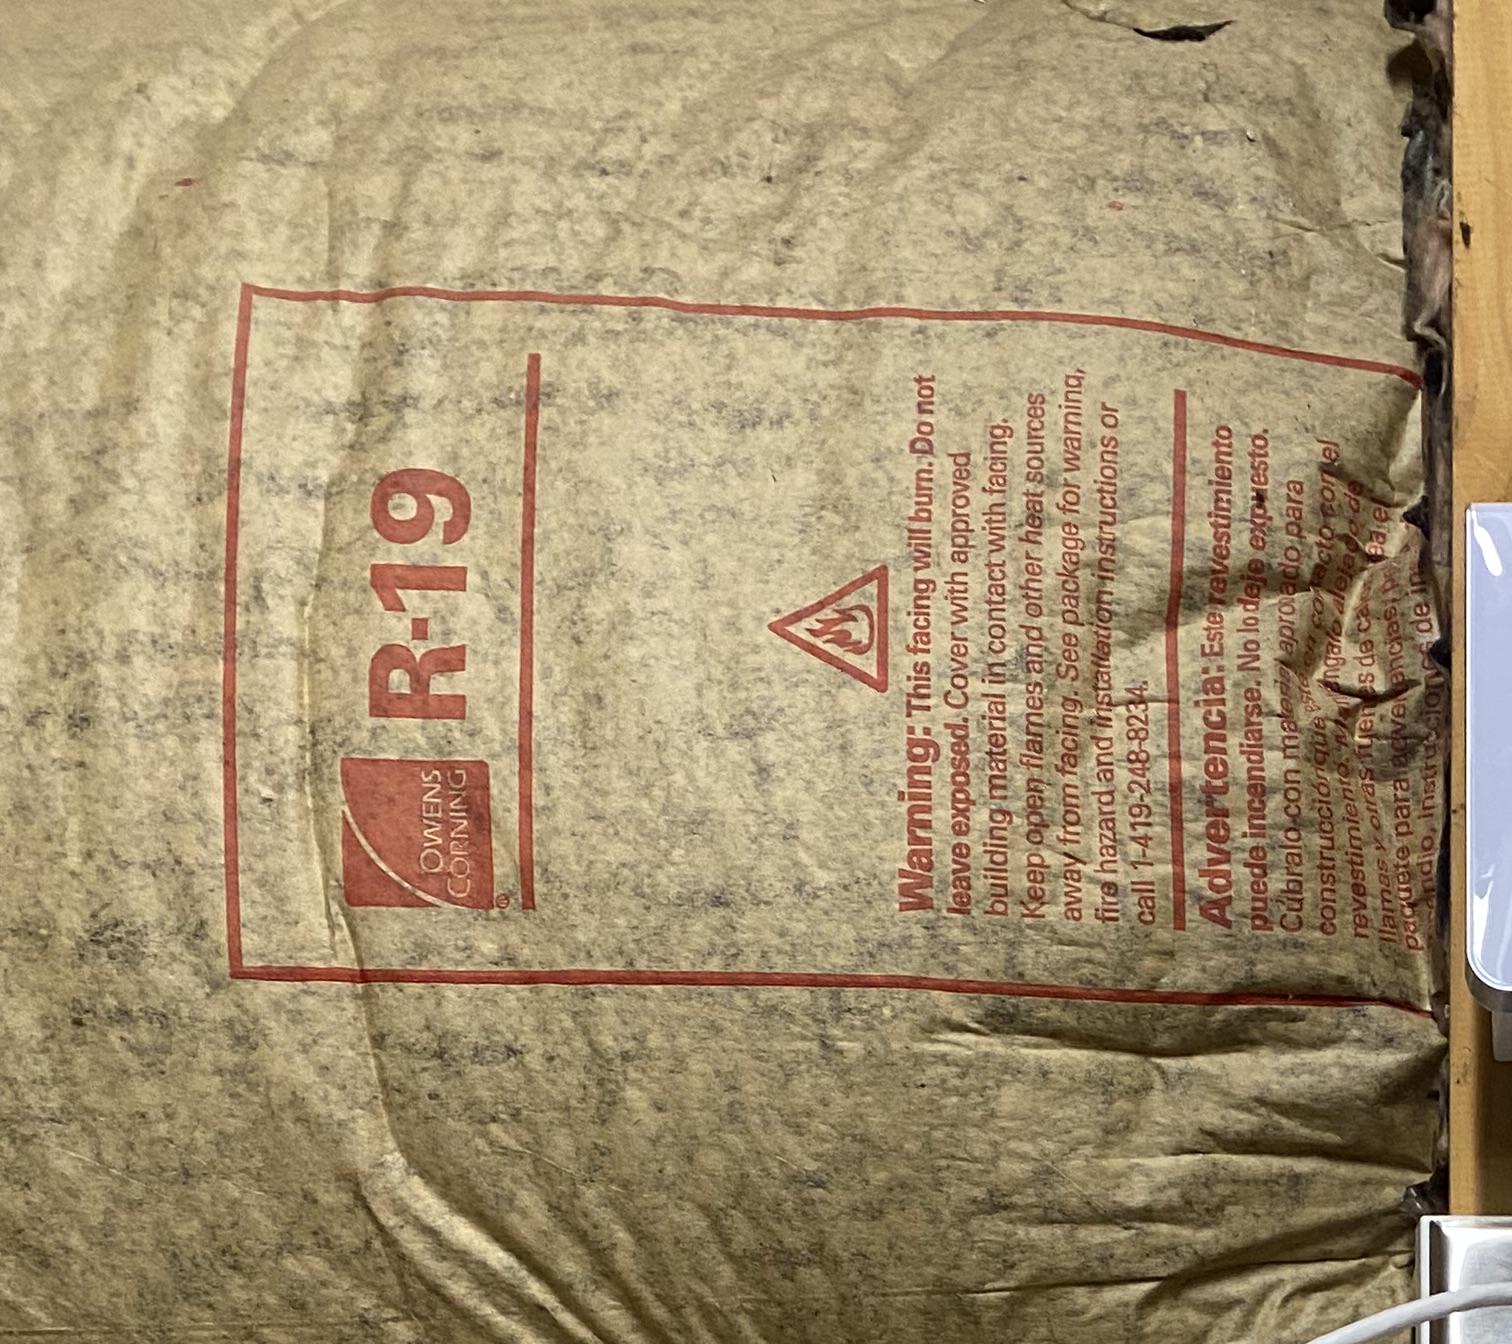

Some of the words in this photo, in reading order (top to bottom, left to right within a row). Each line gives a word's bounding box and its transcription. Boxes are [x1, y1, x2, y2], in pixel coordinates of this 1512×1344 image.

[914, 375, 934, 415] not
[1063, 369, 1084, 472] warning,
[1101, 402, 1118, 430] or
[908, 420, 934, 458] Do
[982, 419, 1014, 495] facing.
[1026, 394, 1045, 482] sources
[907, 463, 933, 525] burn.
[948, 451, 972, 564] approved
[983, 502, 1007, 553] with
[1018, 491, 1044, 545] heat
[1057, 480, 1081, 514] for
[1097, 434, 1119, 580] instructions
[907, 528, 932, 571] will
[1019, 550, 1043, 618] other
[1056, 522, 1084, 626] package
[369, 466, 471, 721] R-19
[905, 577, 938, 655] facing
[947, 572, 968, 626] with
[985, 561, 1007, 654] contact
[943, 633, 969, 710] Cover
[982, 663, 1006, 684] in
[1020, 625, 1045, 673] and
[1056, 632, 1080, 681] See
[1090, 589, 1116, 729] installation
[905, 661, 931, 718] This
[1018, 682, 1044, 770] flames
[982, 693, 1007, 800] material
[1056, 692, 1084, 777] facing.
[1090, 735, 1114, 783] and
[944, 717, 976, 838] exposed.
[1025, 776, 1049, 847] open
[1124, 681, 1152, 869] 1-419-248-8234.
[418, 769, 443, 871] OWENS
[445, 769, 470, 898] CORNING
[896, 723, 941, 912] Warning:
[1057, 783, 1081, 845] from
[1092, 788, 1119, 874] hazard
[947, 842, 972, 916] leave
[983, 808, 1014, 917] building
[1020, 852, 1049, 919] Keep
[1063, 853, 1087, 922] away
[1095, 880, 1118, 922] fire
[1132, 880, 1156, 927] call
